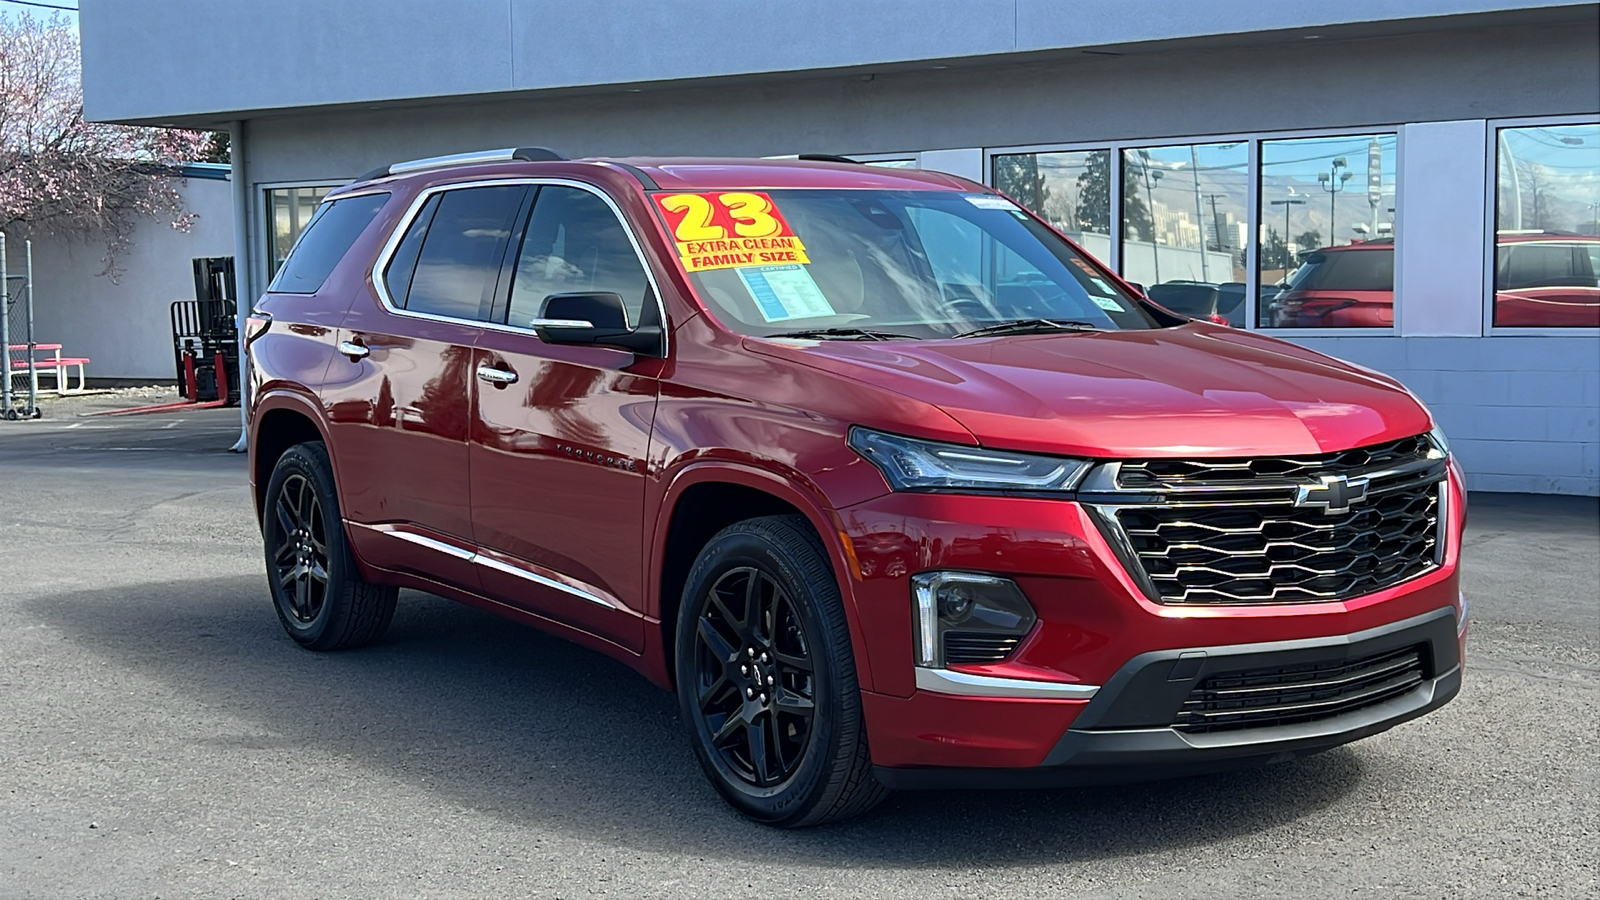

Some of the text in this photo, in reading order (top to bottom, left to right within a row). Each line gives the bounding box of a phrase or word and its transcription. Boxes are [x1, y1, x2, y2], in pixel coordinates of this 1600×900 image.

[660, 192, 782, 241] 23
[686, 238, 796, 255] EXTRA CLEAN
[691, 251, 798, 268] FAMILY SIZE
[556, 443, 635, 472] TRAVERSE
